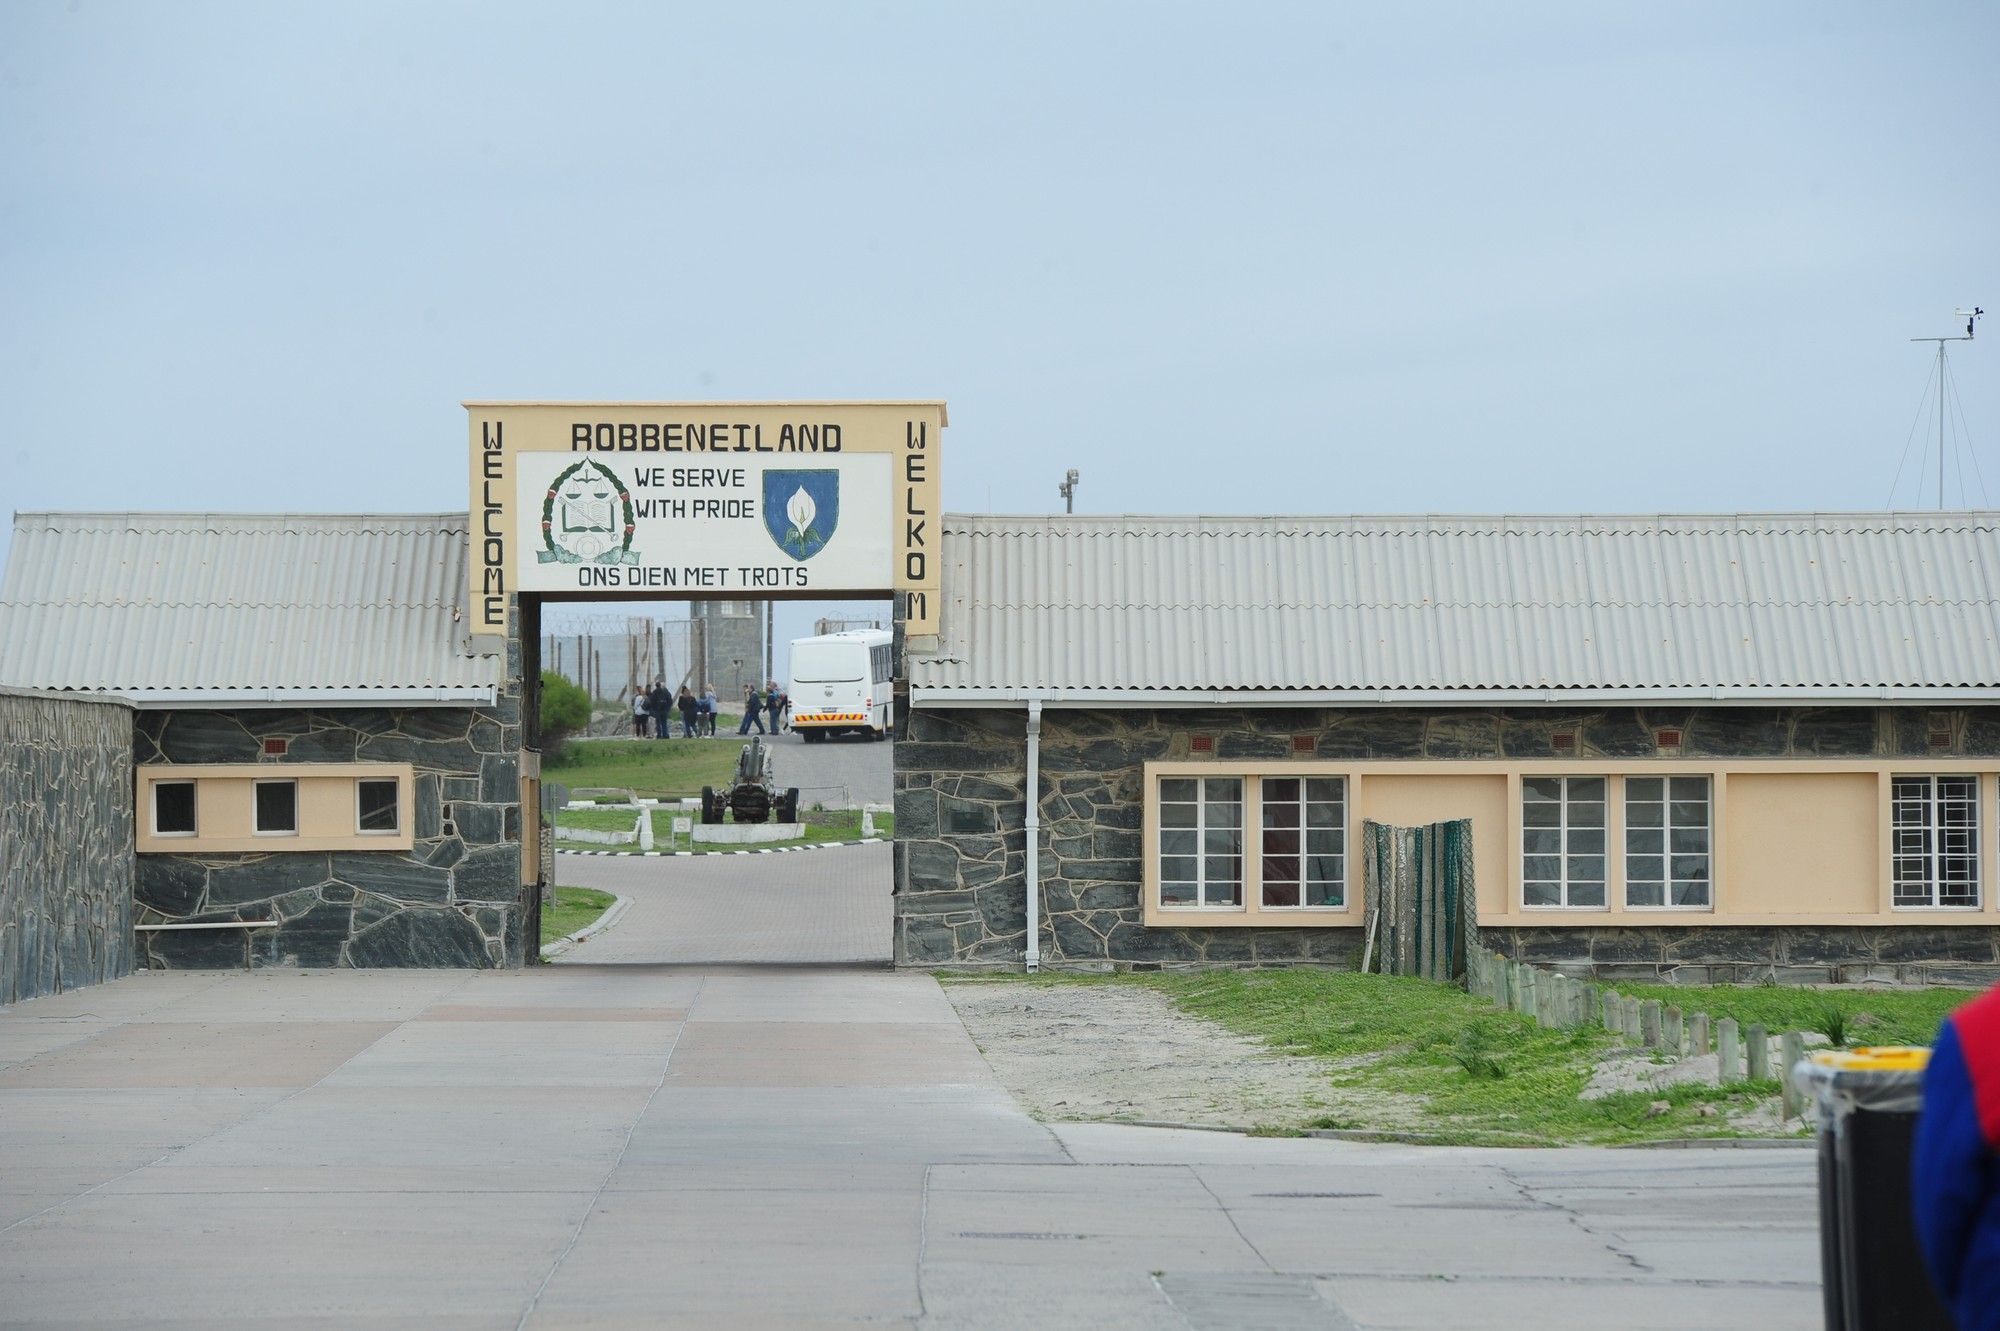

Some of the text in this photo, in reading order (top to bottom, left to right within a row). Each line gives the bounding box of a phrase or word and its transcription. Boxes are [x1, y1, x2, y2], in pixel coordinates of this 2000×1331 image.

[571, 423, 842, 452] ROBBENEILAND
[634, 467, 746, 488] WE SERVE
[635, 499, 755, 519] WITH PRIDE
[906, 421, 926, 621] WELKOM
[482, 421, 504, 625] WELCOME
[578, 566, 809, 587] ONS DIEN MET TROTS
